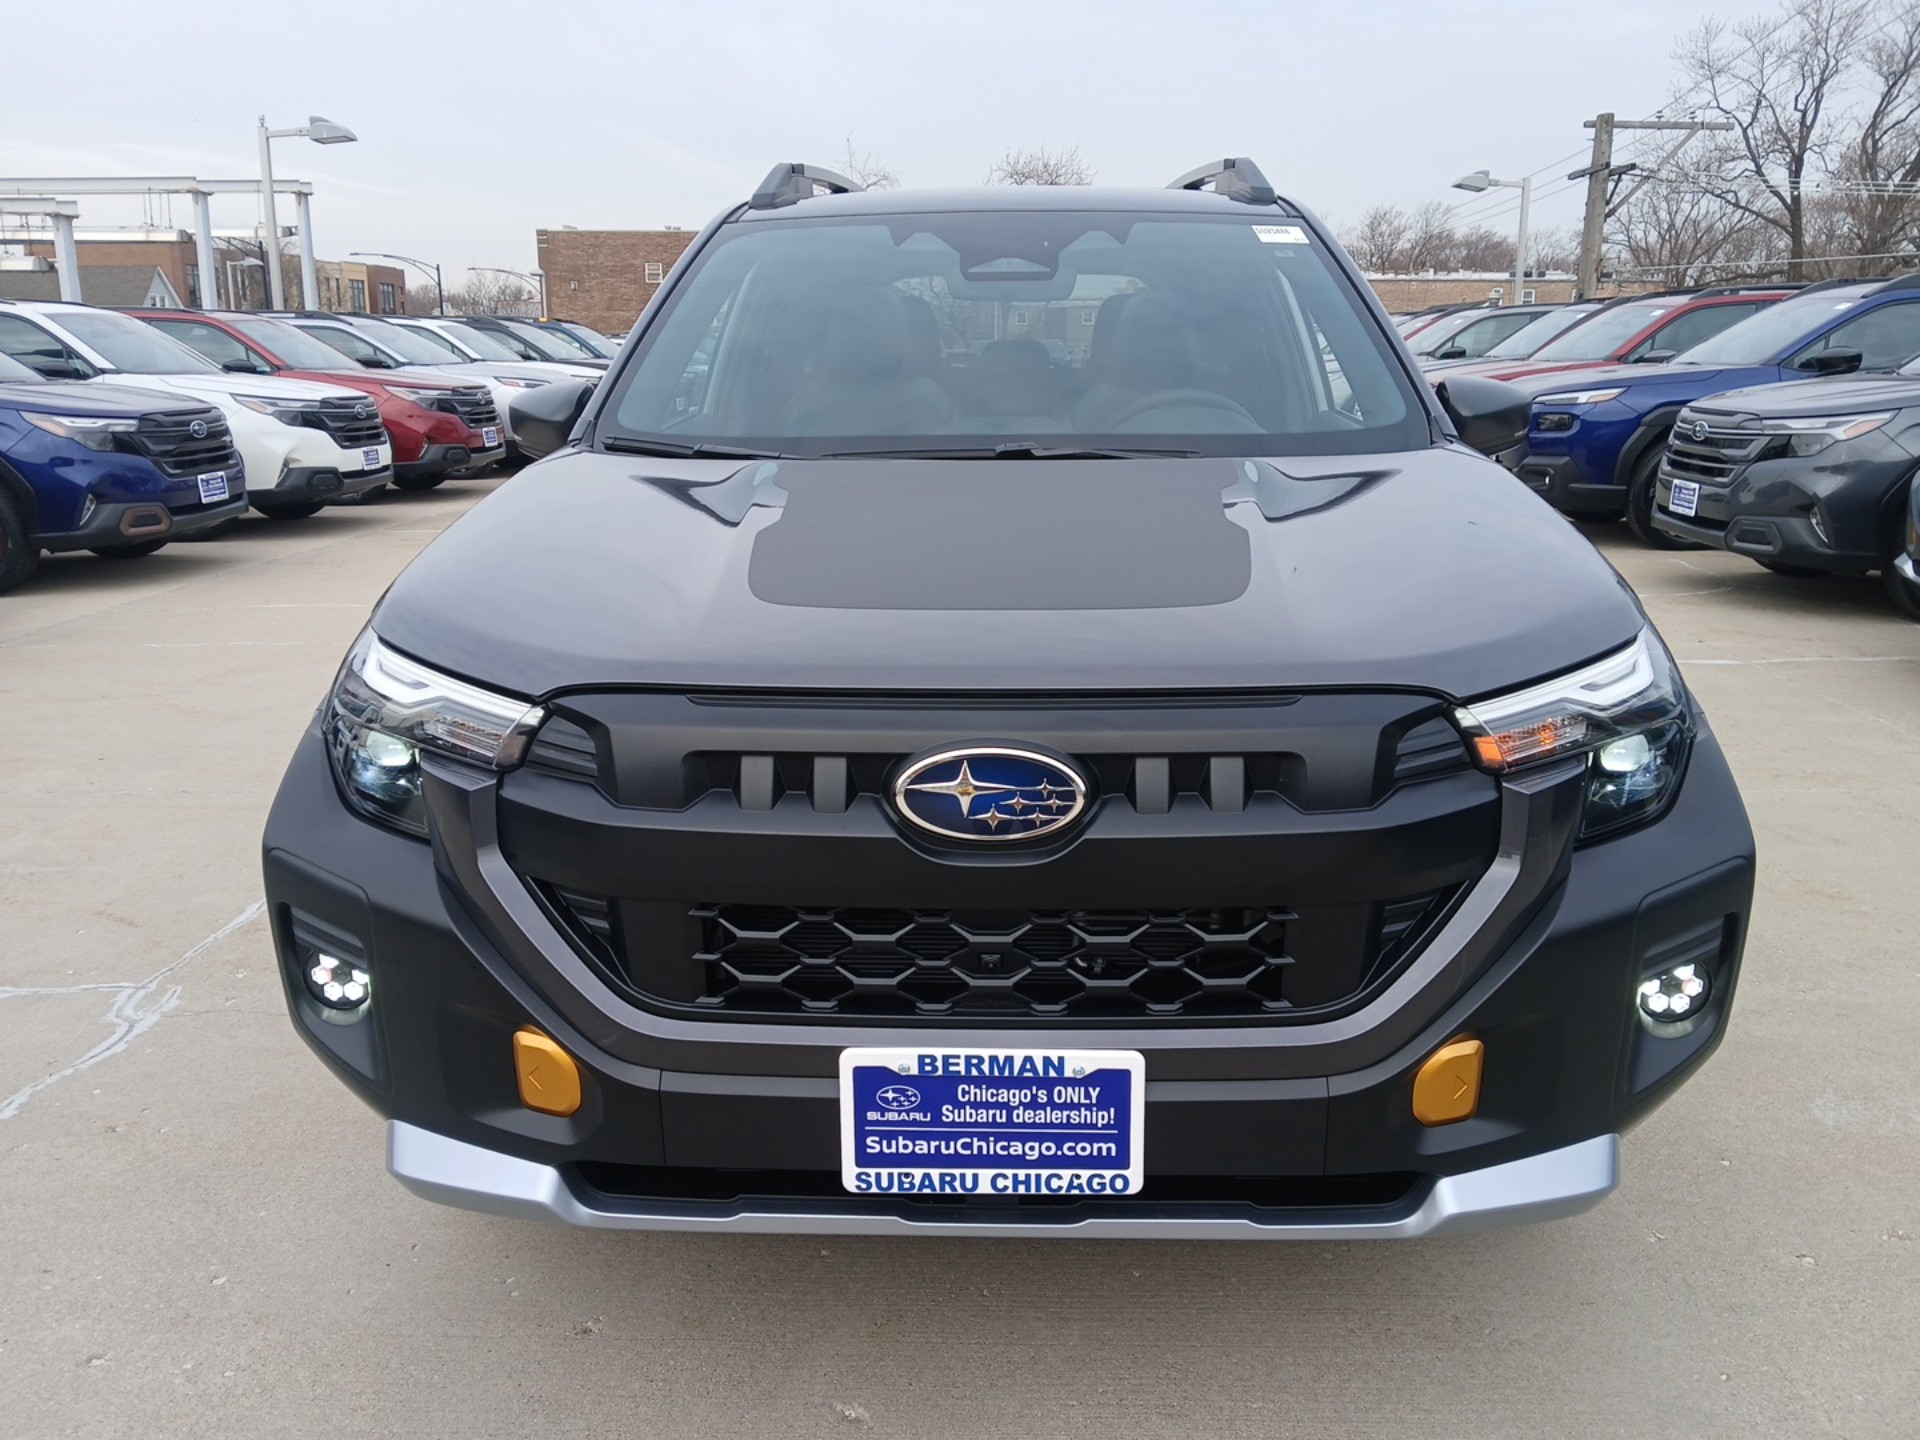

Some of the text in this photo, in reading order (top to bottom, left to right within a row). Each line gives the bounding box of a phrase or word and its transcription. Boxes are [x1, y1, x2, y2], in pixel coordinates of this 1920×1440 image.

[917, 1054, 1065, 1077] BERMAN
[957, 1084, 1100, 1106] Chicago's ONLY
[866, 1111, 931, 1122] SUBARU
[941, 1105, 1115, 1128] Subaru dealership!
[865, 1136, 1117, 1160] SubaruChicago.com
[855, 1171, 1130, 1194] SUBARU CHICAGO
